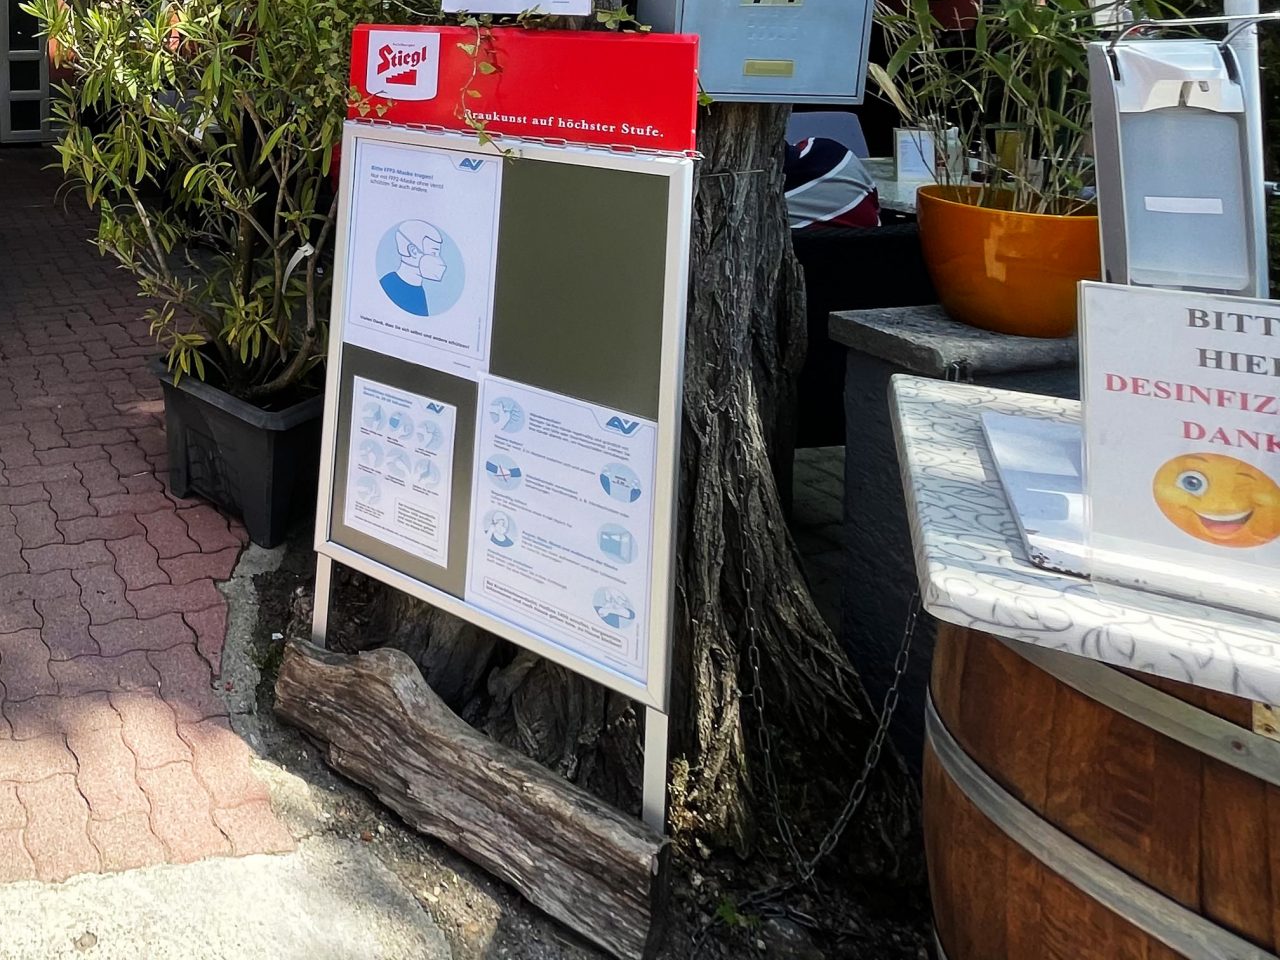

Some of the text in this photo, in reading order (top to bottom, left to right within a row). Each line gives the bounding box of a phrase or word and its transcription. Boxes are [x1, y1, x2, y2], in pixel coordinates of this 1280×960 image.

[377, 44, 427, 75] Stiegl
[464, 108, 664, 138] Braukunst auf höchster Stufe.
